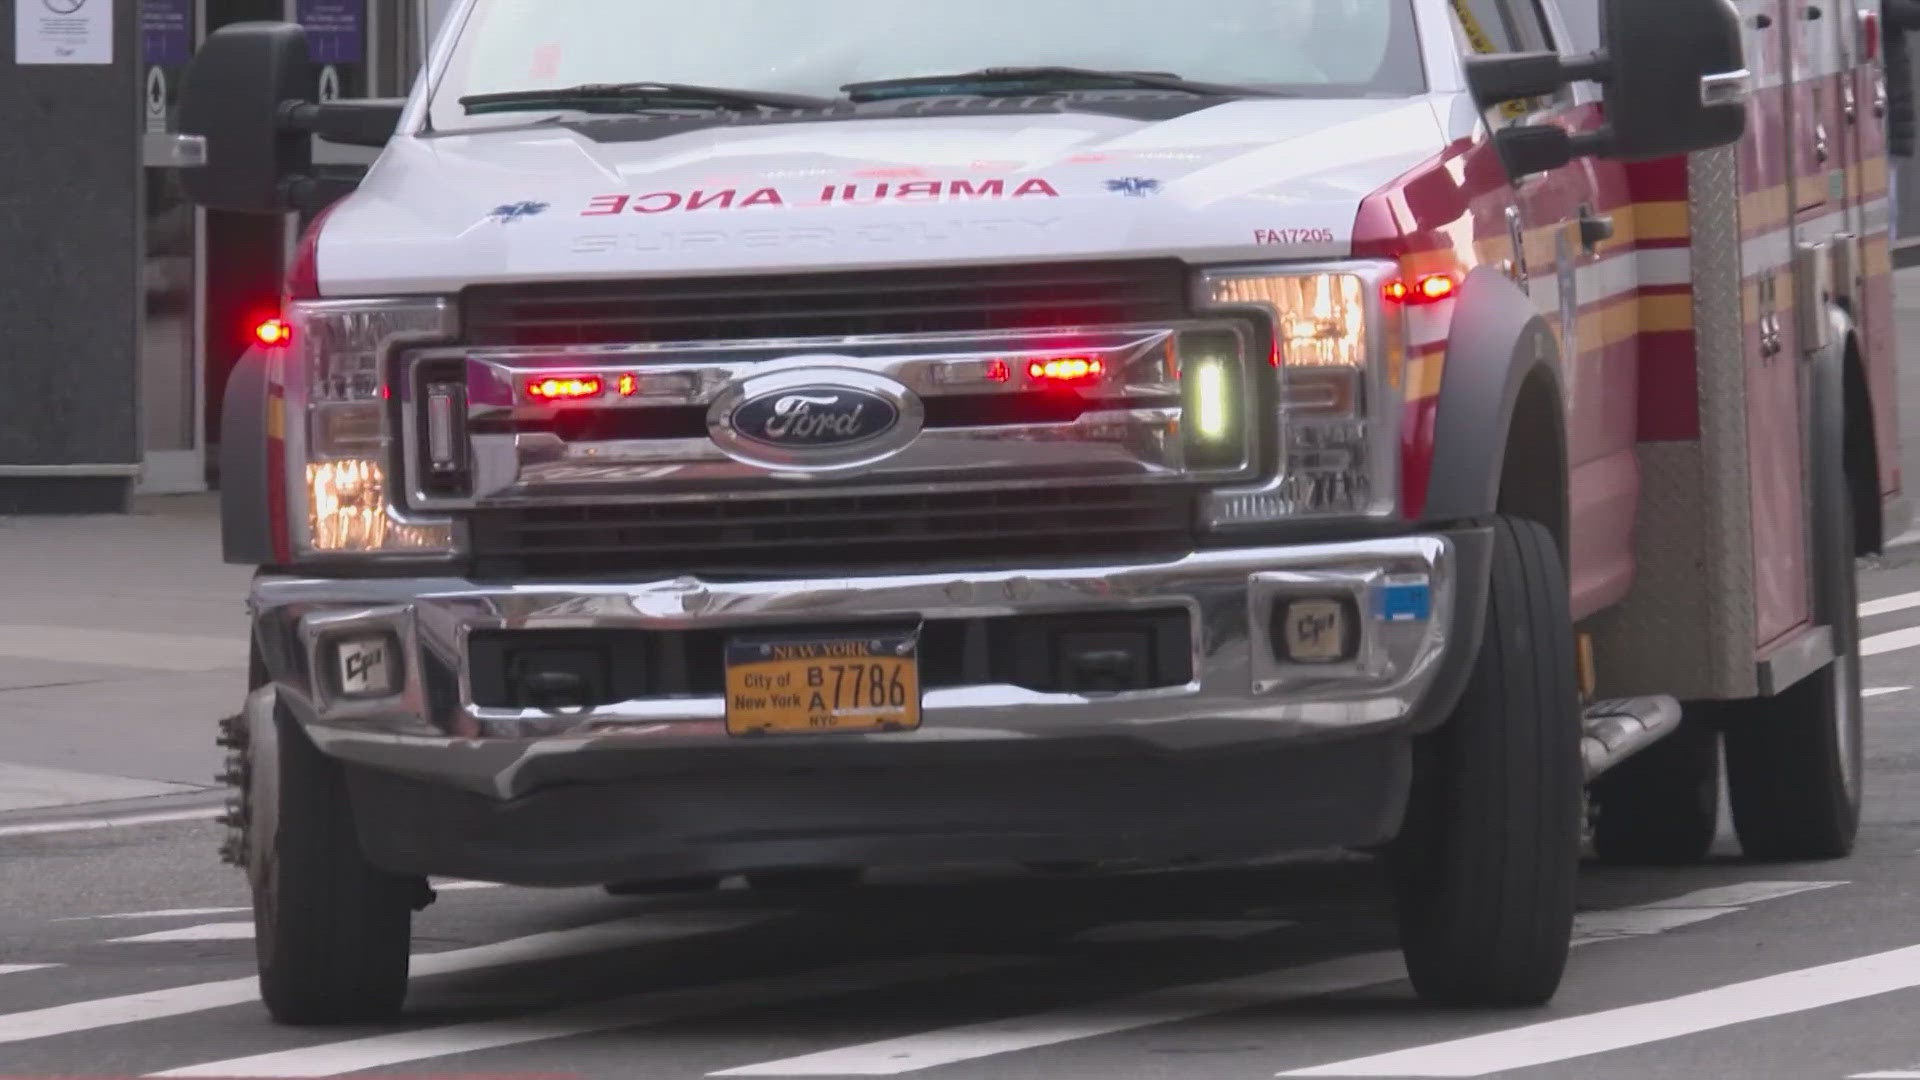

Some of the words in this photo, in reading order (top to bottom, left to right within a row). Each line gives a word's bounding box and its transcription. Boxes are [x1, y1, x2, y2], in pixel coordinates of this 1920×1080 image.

[571, 226, 835, 253] SUPER
[854, 216, 1062, 242] DUTY
[1254, 227, 1334, 244] FA17205
[765, 395, 864, 437] Ford
[773, 645, 816, 660] NEW
[824, 641, 871, 657] YORK
[744, 672, 773, 690] City
[777, 671, 792, 687] of
[807, 666, 824, 687] B
[829, 664, 906, 709] 7786
[735, 696, 767, 711] New
[771, 694, 802, 708] York
[809, 691, 826, 712] A
[809, 714, 839, 727] NYC
